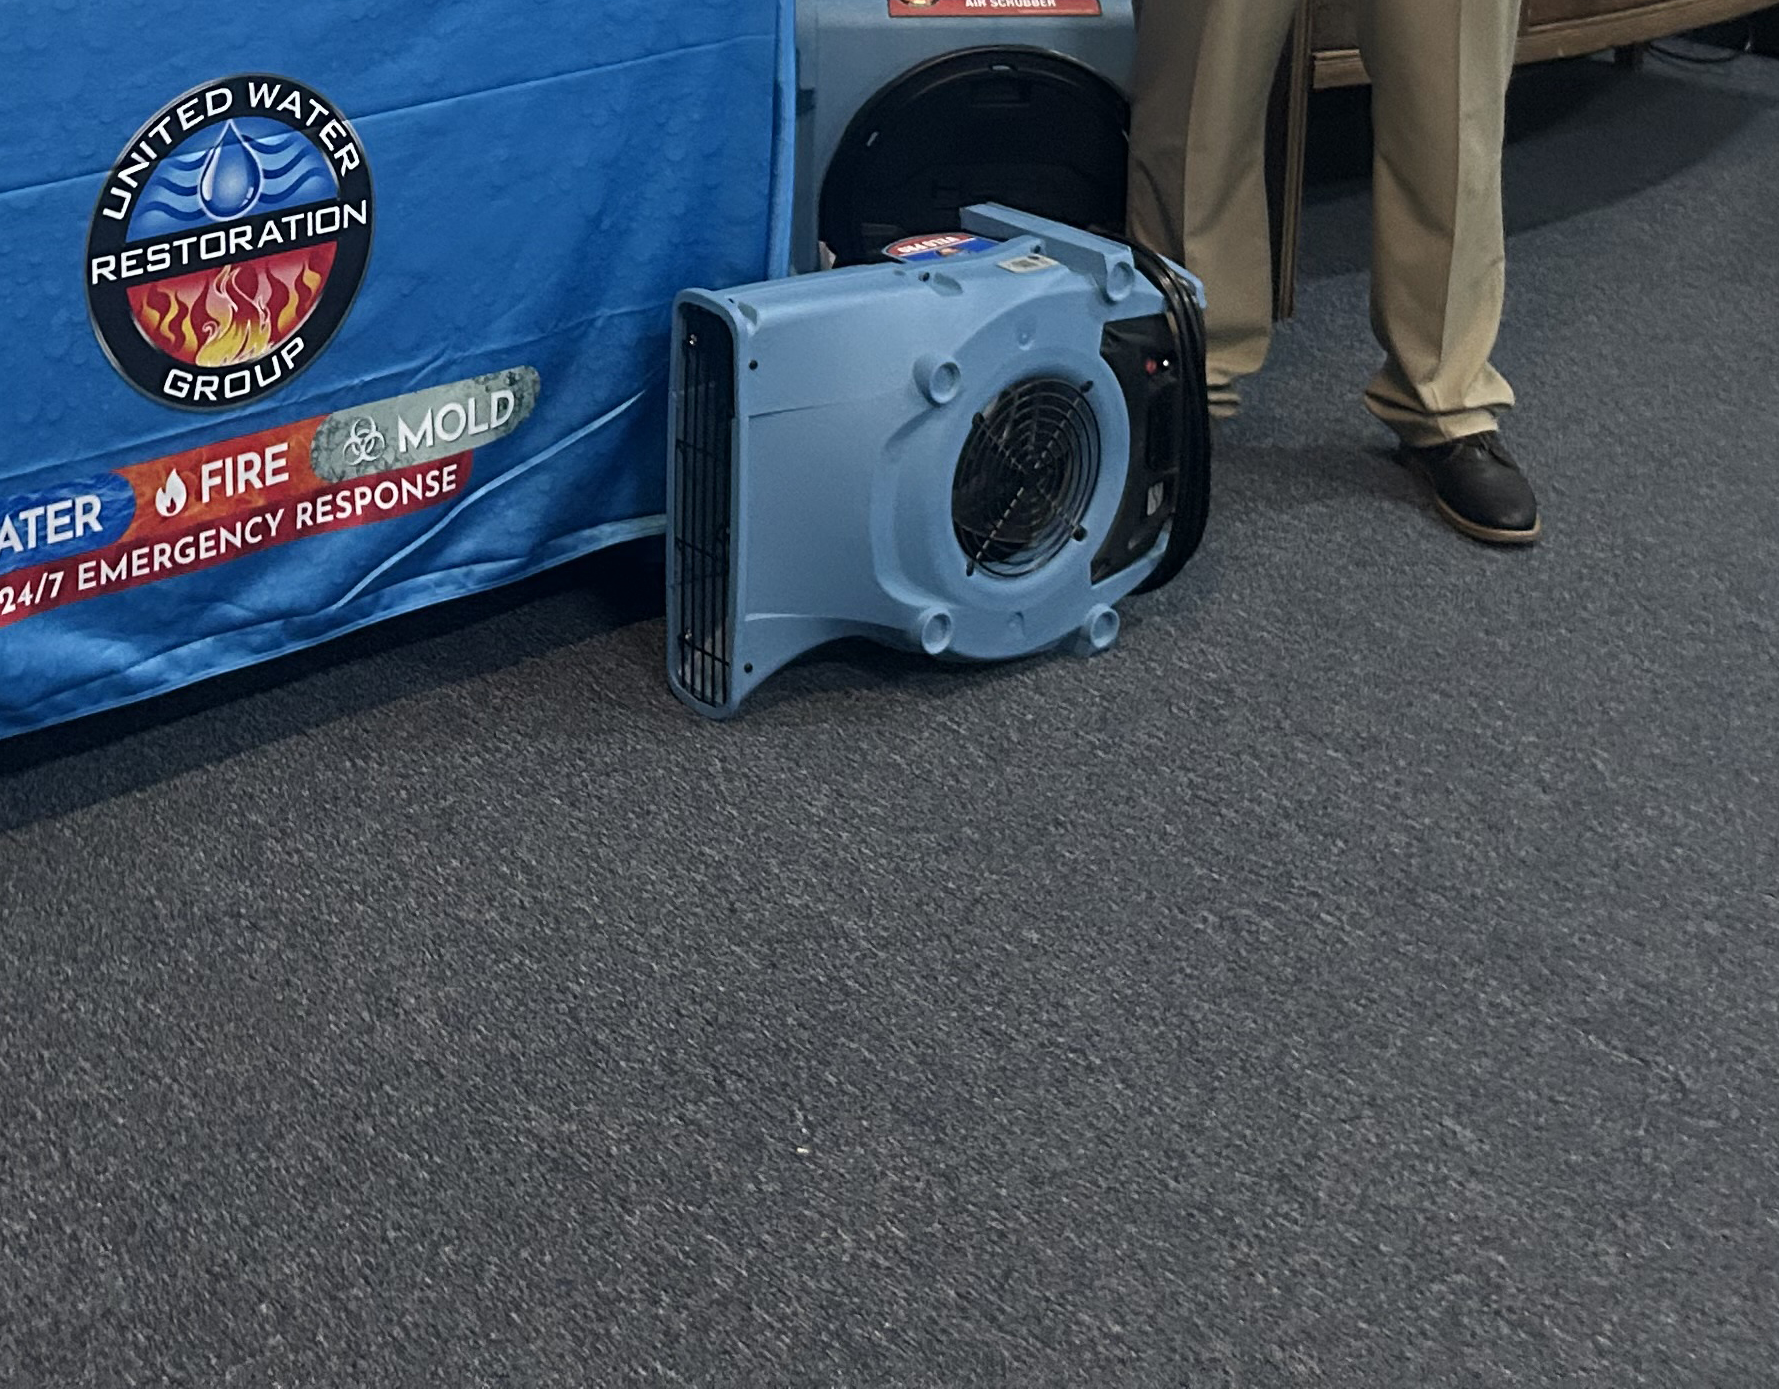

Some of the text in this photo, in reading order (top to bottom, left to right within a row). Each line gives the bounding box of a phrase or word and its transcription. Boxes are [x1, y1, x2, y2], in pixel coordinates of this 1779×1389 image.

[103, 82, 360, 220] UNITED WATER
[91, 200, 367, 285] RESTORATION
[163, 336, 305, 401] GROUP
[201, 442, 289, 503] FIRE
[397, 389, 515, 453] MOLD
[77, 508, 285, 591] EMERGENCY
[295, 464, 458, 529] RESPONSE
